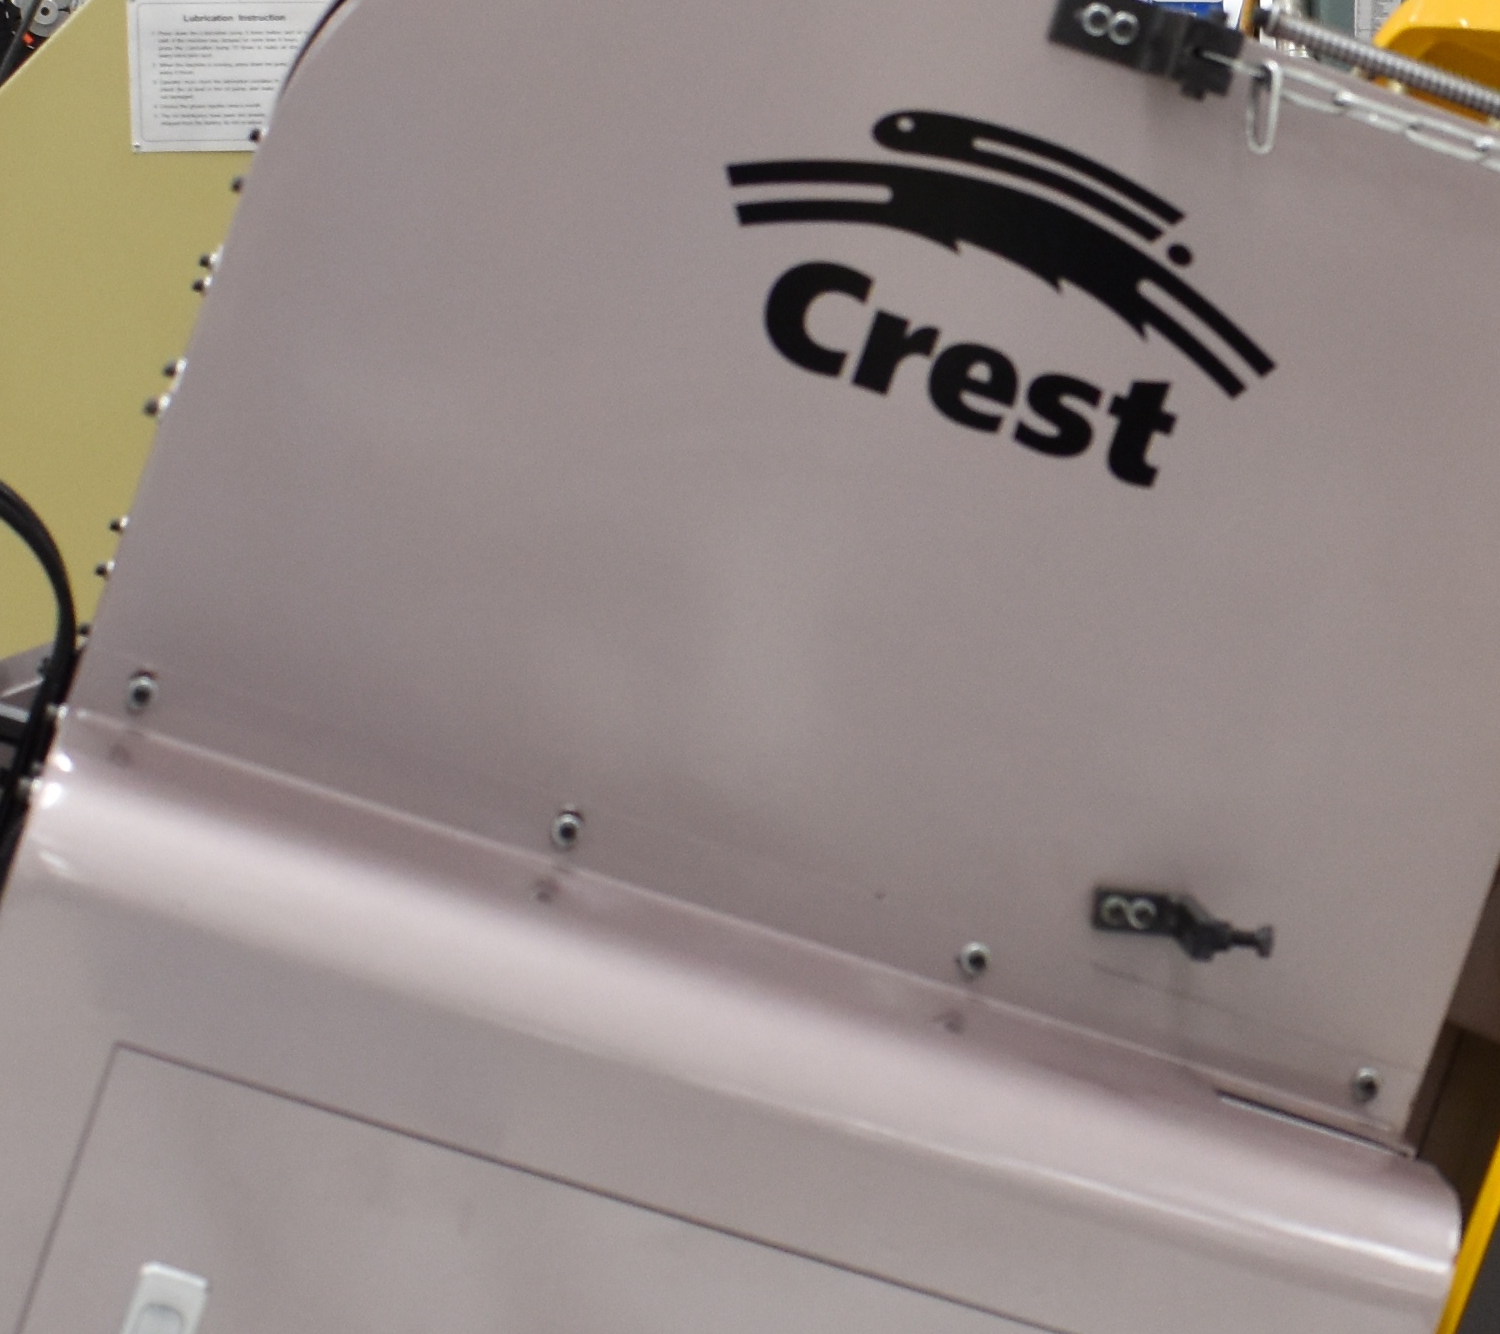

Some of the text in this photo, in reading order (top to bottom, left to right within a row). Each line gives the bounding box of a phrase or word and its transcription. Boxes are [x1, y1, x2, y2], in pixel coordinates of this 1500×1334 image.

[183, 14, 286, 22] Lubrication Instruction
[763, 260, 1178, 490] Crest
